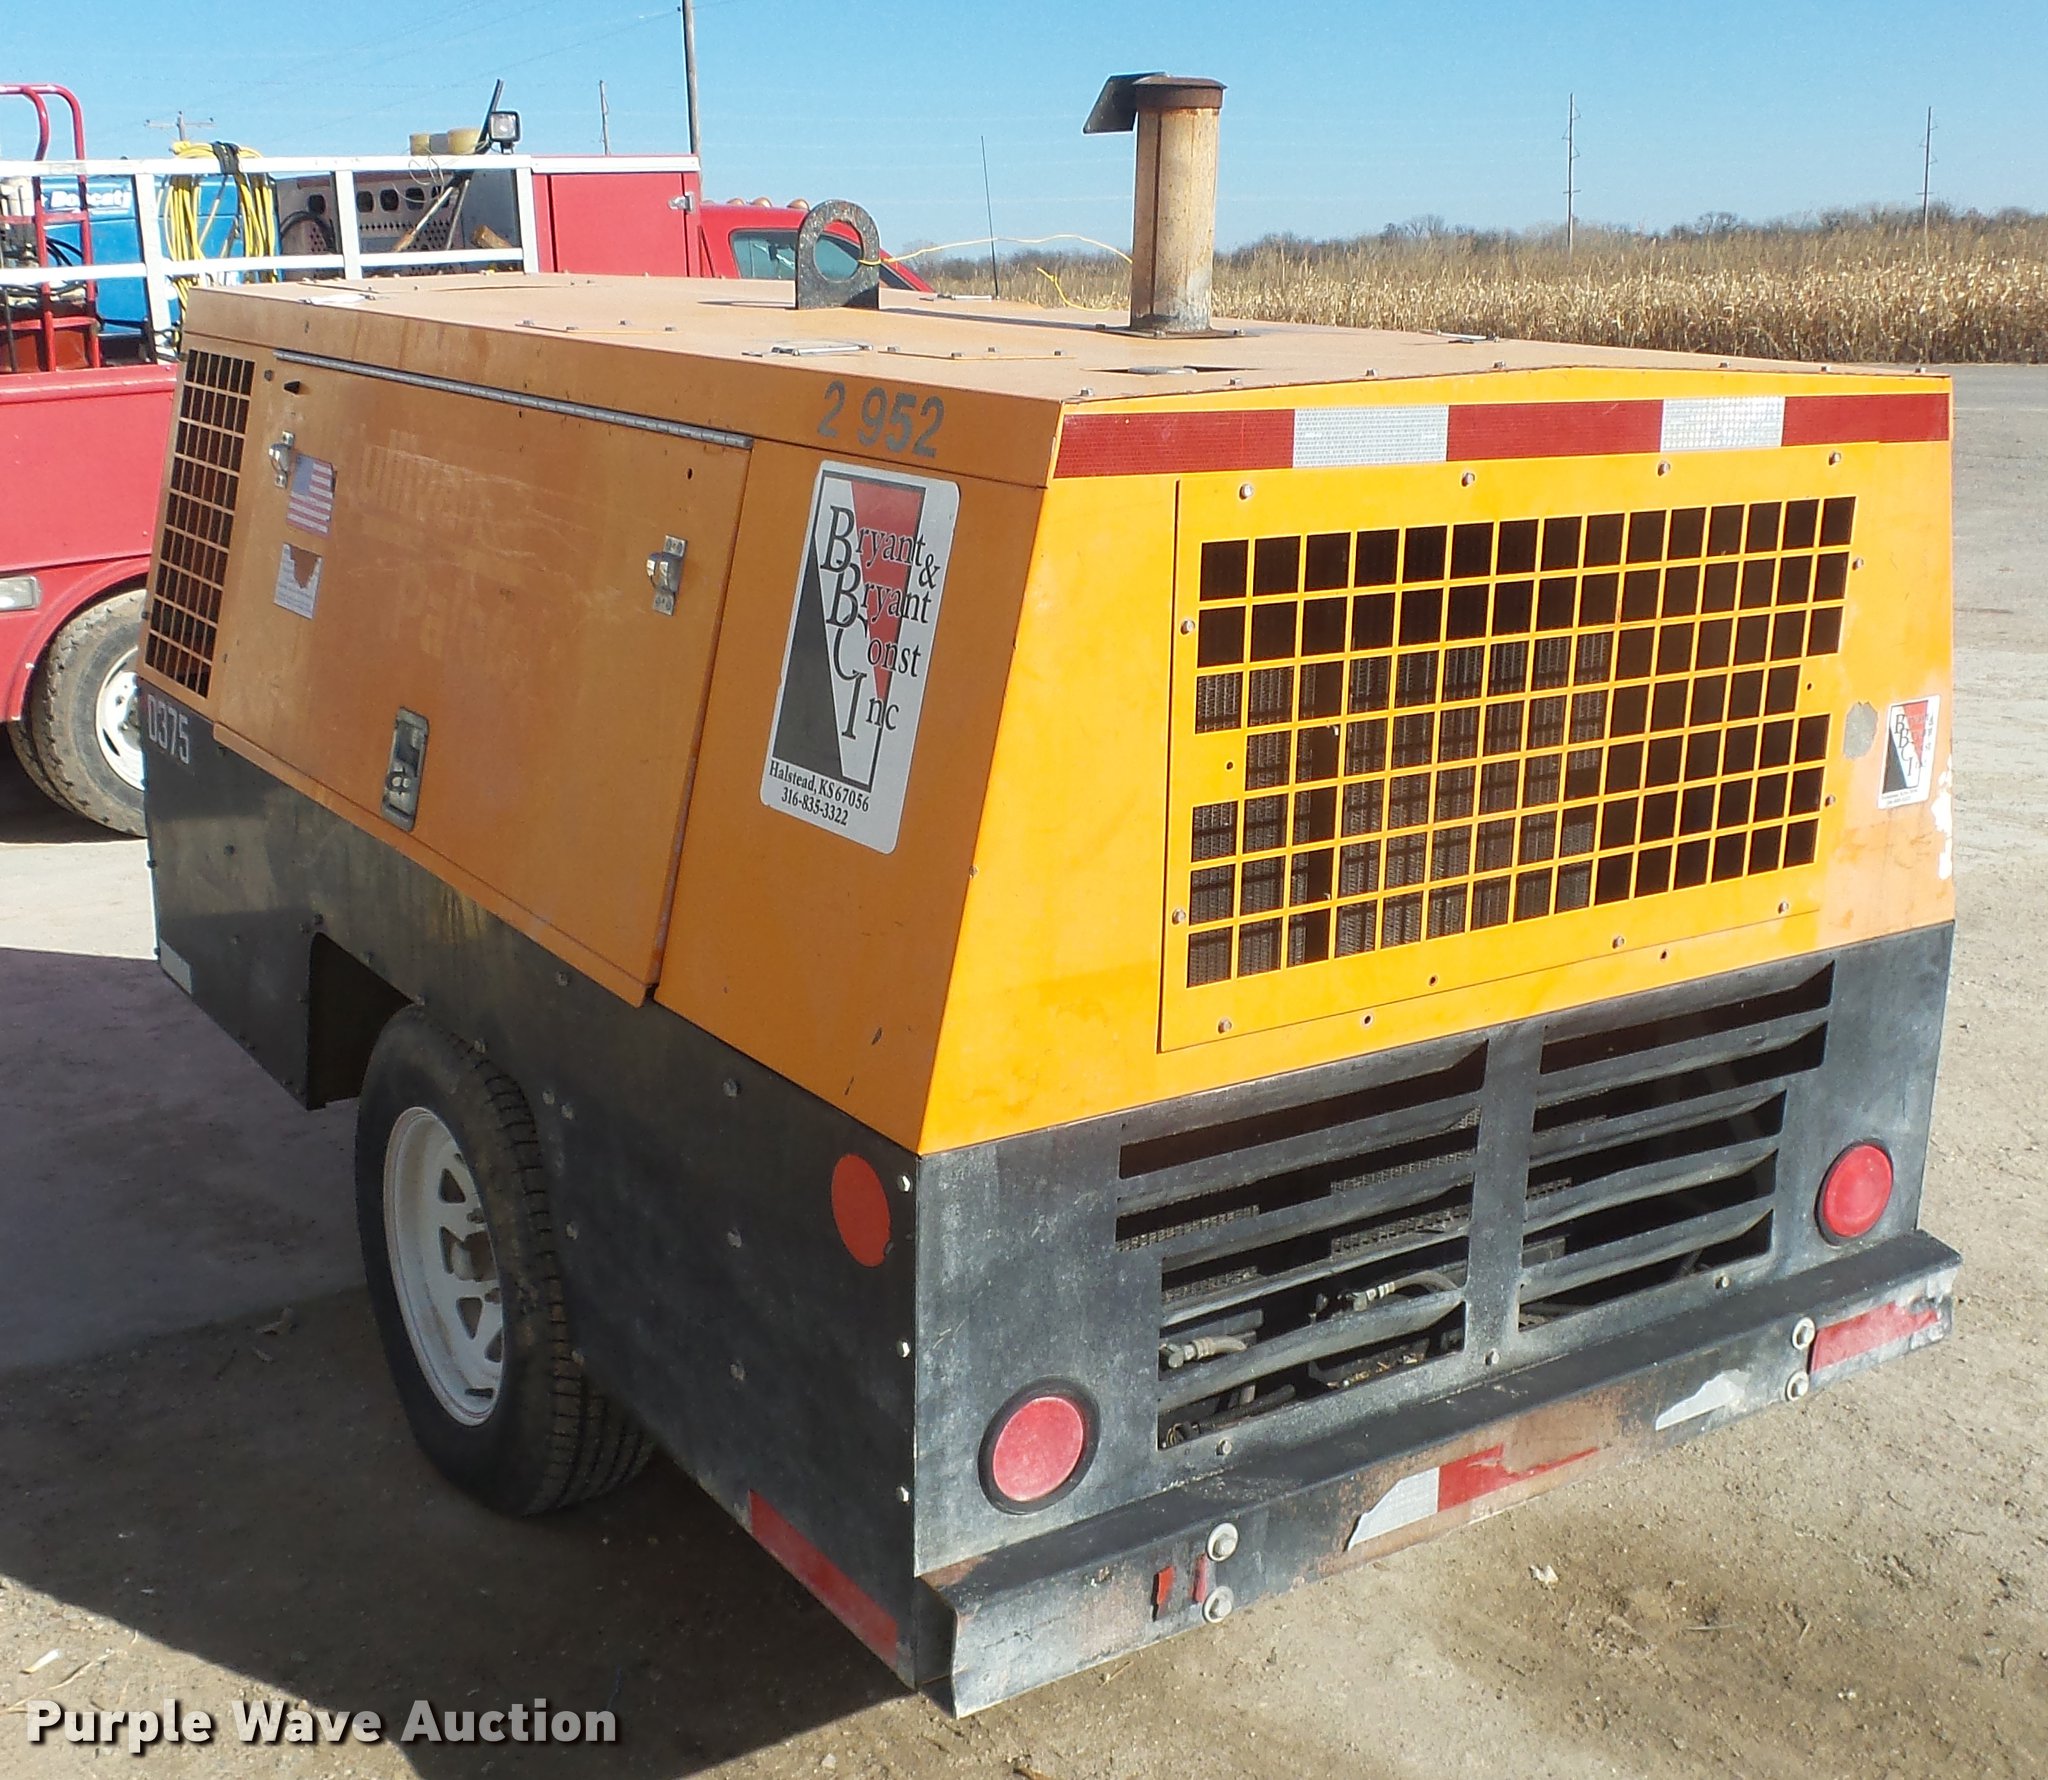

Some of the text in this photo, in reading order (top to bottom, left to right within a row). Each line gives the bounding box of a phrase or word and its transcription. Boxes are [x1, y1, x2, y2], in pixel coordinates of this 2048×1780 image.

[817, 380, 945, 458] 2 952
[820, 505, 941, 590] Bryant &
[826, 562, 932, 628] Bryant
[833, 614, 921, 681] Const
[147, 694, 190, 765] 0375
[841, 669, 899, 740] Inc
[769, 760, 870, 813] Halstead, KS 67056
[781, 786, 849, 826] 316-835-3322
